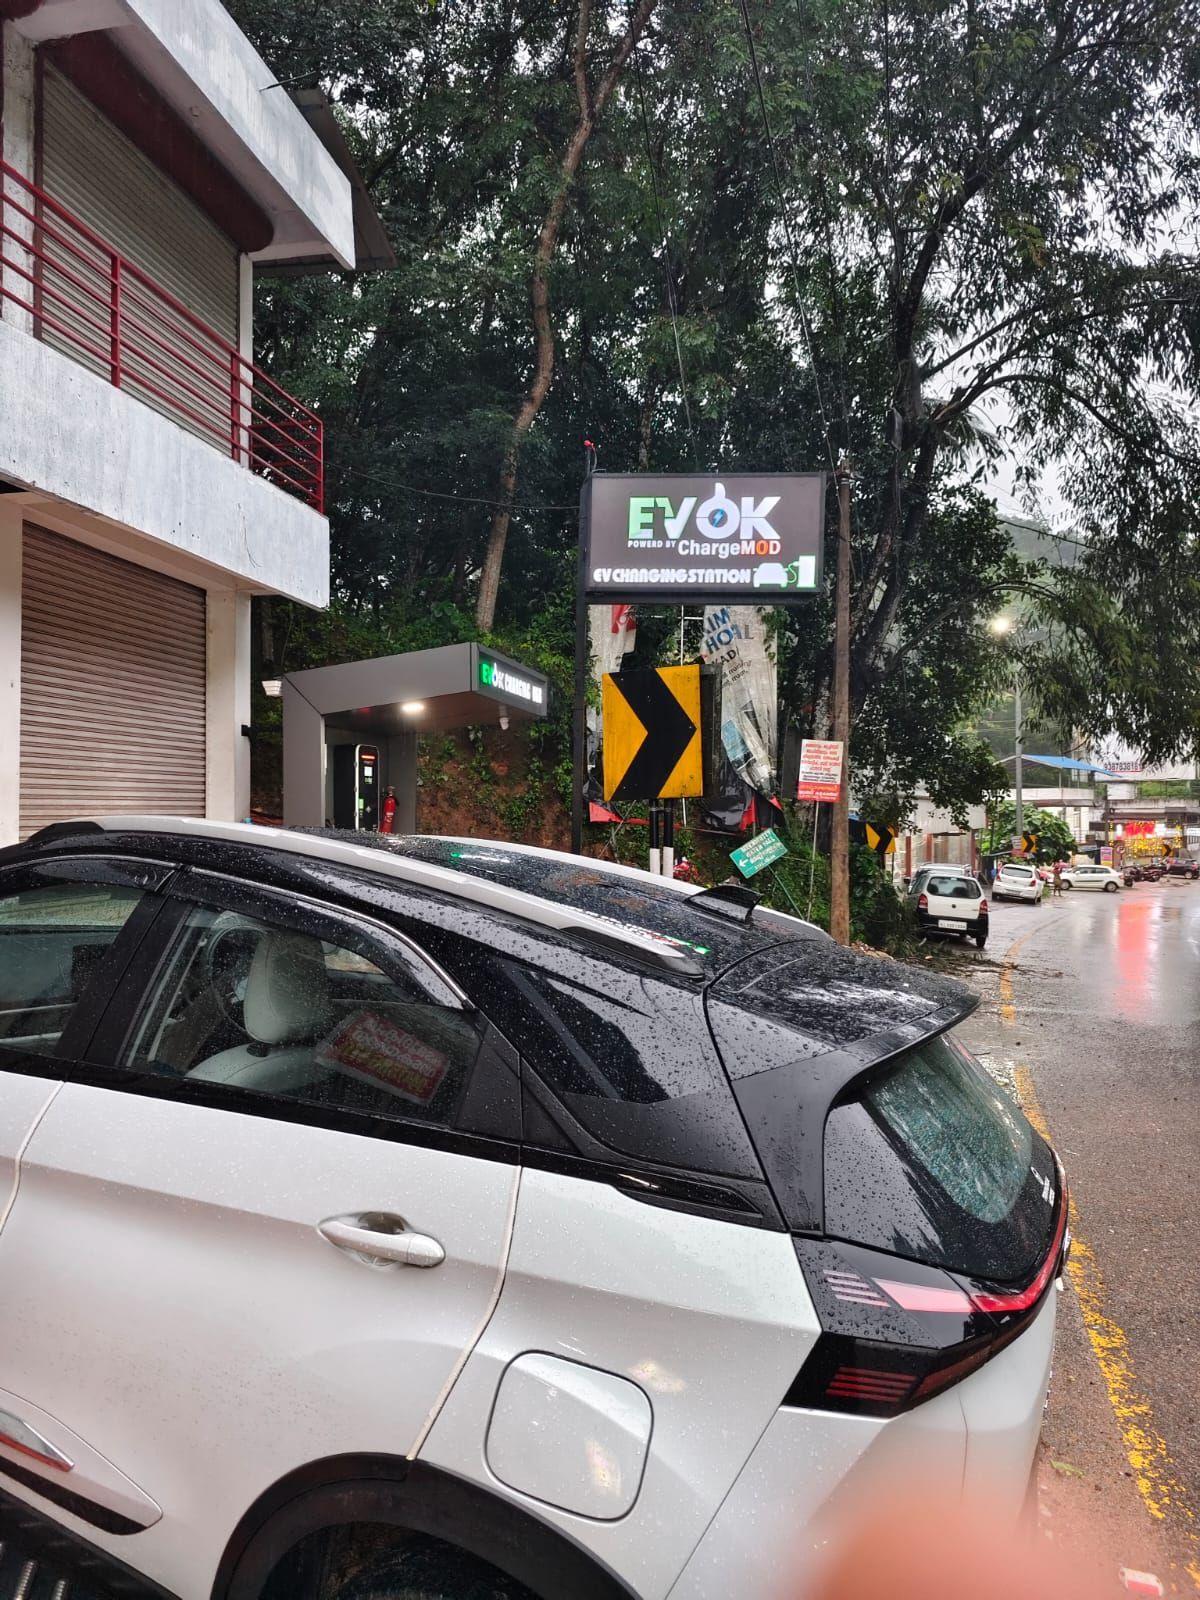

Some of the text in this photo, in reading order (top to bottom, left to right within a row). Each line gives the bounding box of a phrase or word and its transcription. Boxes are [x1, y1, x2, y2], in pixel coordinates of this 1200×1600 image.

[628, 483, 781, 540] EVOK
[665, 540, 677, 549] BY
[678, 540, 781, 559] ChargeMOD
[593, 568, 612, 583] EV
[688, 568, 751, 583] STATION
